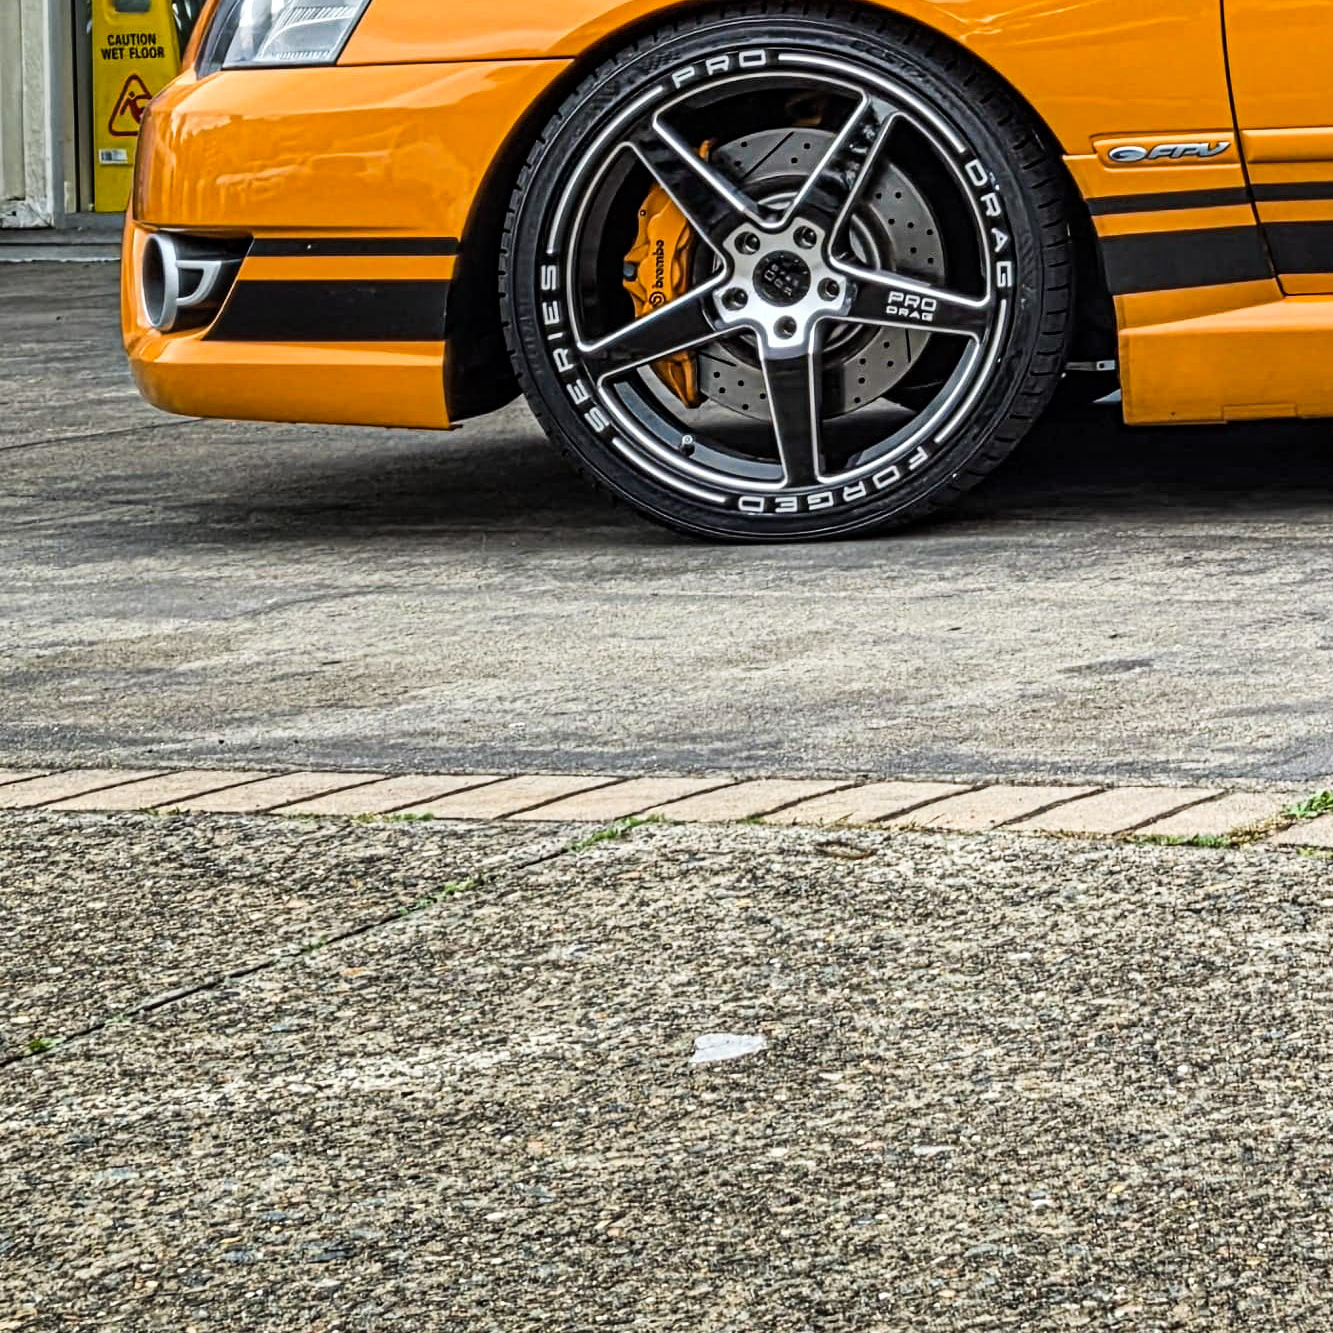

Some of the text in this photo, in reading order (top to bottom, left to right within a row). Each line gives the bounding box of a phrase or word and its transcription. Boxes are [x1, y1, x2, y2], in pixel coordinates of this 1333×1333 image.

[101, 46, 165, 60] WET FLOOR
[107, 33, 157, 46] CAUTION
[671, 48, 768, 89] PRO
[964, 160, 1015, 289] DRAG
[652, 239, 666, 289] brembo
[886, 305, 934, 322] DRAG
[887, 290, 937, 312] PRO
[541, 263, 612, 436] SERIES
[737, 445, 929, 514] FORGED
